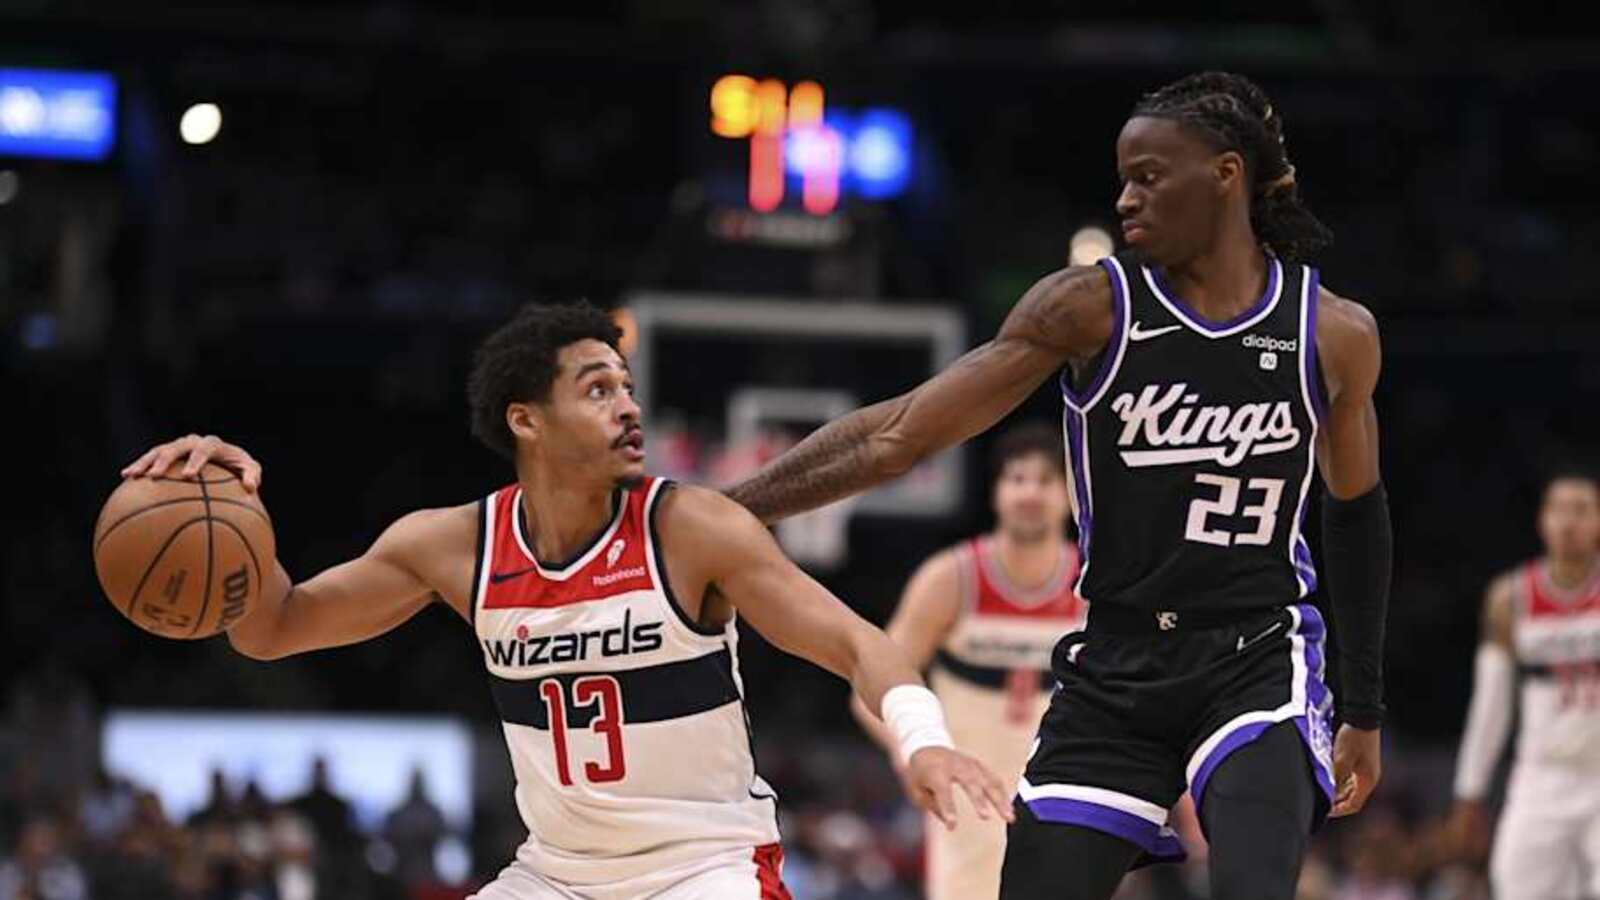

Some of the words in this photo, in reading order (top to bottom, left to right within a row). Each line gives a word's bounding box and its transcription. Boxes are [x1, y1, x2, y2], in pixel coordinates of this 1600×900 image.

[1242, 334, 1297, 352] dialpad
[1111, 383, 1300, 467] Kings
[1184, 473, 1286, 547] 23
[540, 675, 626, 787] 13
